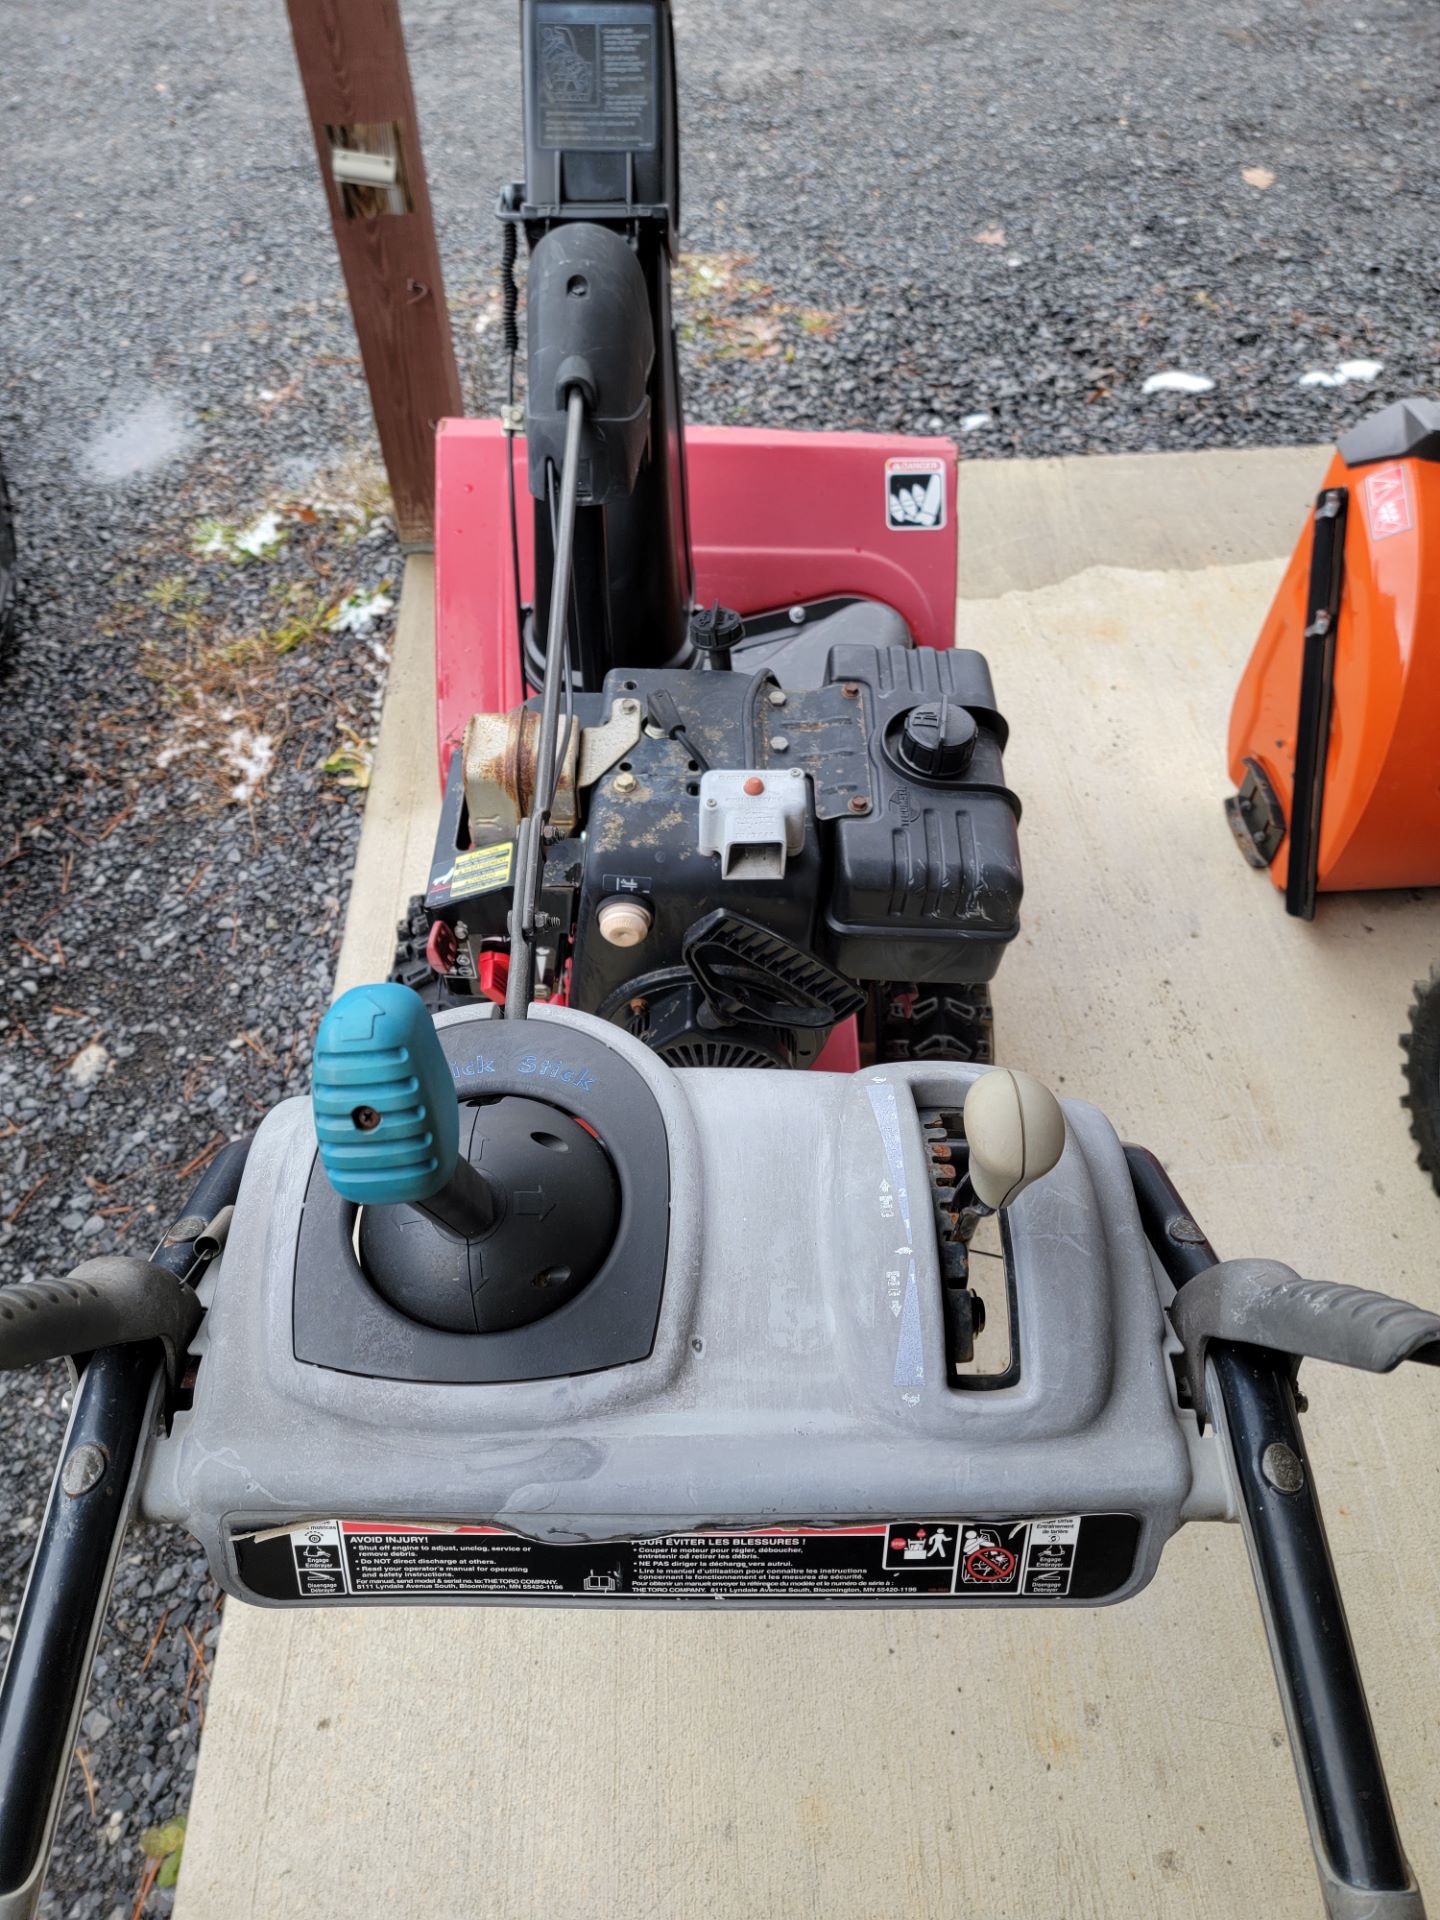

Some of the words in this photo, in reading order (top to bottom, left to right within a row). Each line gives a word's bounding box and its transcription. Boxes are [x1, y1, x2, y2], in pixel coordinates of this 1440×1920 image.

[452, 1055, 496, 1078] ick
[518, 1055, 598, 1092] Stick
[898, 1188, 907, 1197] 2
